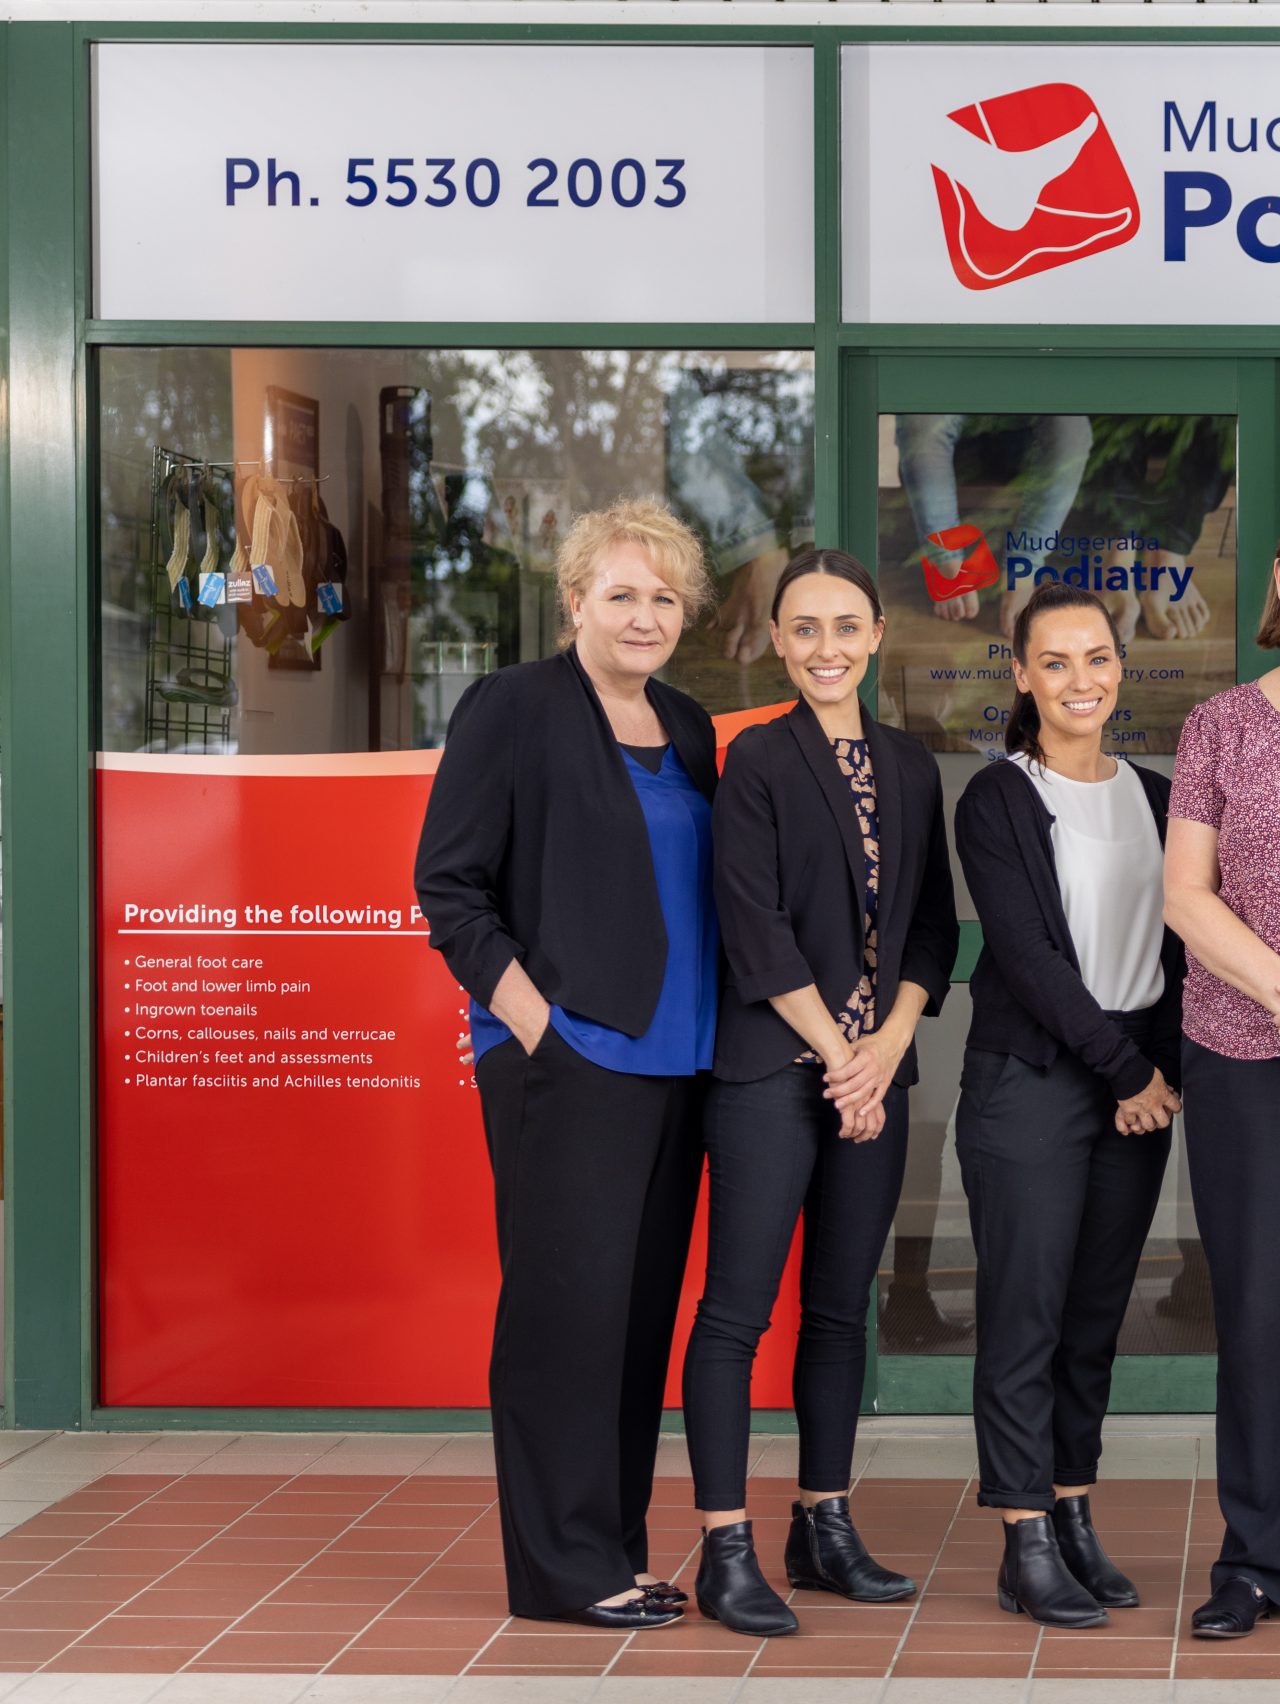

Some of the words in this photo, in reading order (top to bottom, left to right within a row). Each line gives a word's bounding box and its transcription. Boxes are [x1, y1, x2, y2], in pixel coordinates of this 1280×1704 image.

[226, 159, 318, 206] Ph.
[346, 158, 500, 207] 5530
[528, 158, 687, 208] 2003
[1006, 529, 1160, 557] Mudgeeraba
[1006, 554, 1194, 602] Podiatry
[125, 903, 237, 929] Providing
[244, 904, 283, 924] the
[290, 904, 402, 929] following
[135, 955, 193, 969] General
[196, 955, 228, 969] foot
[231, 957, 263, 969] care
[135, 978, 168, 993] Foot
[171, 979, 198, 993] and
[202, 979, 242, 993] lower
[246, 979, 277, 993] limb
[281, 980, 311, 996] pain
[135, 1003, 196, 1020] Ingrown
[200, 1003, 258, 1017] toenails
[135, 1026, 183, 1042] Corns,
[187, 1027, 259, 1042] callouses,
[264, 1027, 297, 1041] nails
[301, 1027, 328, 1041] and
[332, 1029, 396, 1041] verrucae
[135, 1050, 211, 1064] Children’s
[214, 1050, 244, 1064] feet
[248, 1050, 276, 1064] and
[280, 1051, 373, 1065] assessments
[136, 1073, 188, 1088] Plantar
[192, 1074, 248, 1088] fasciitis
[252, 1074, 279, 1088] and
[284, 1074, 342, 1089] Achilles
[346, 1075, 421, 1089] tendonitis
